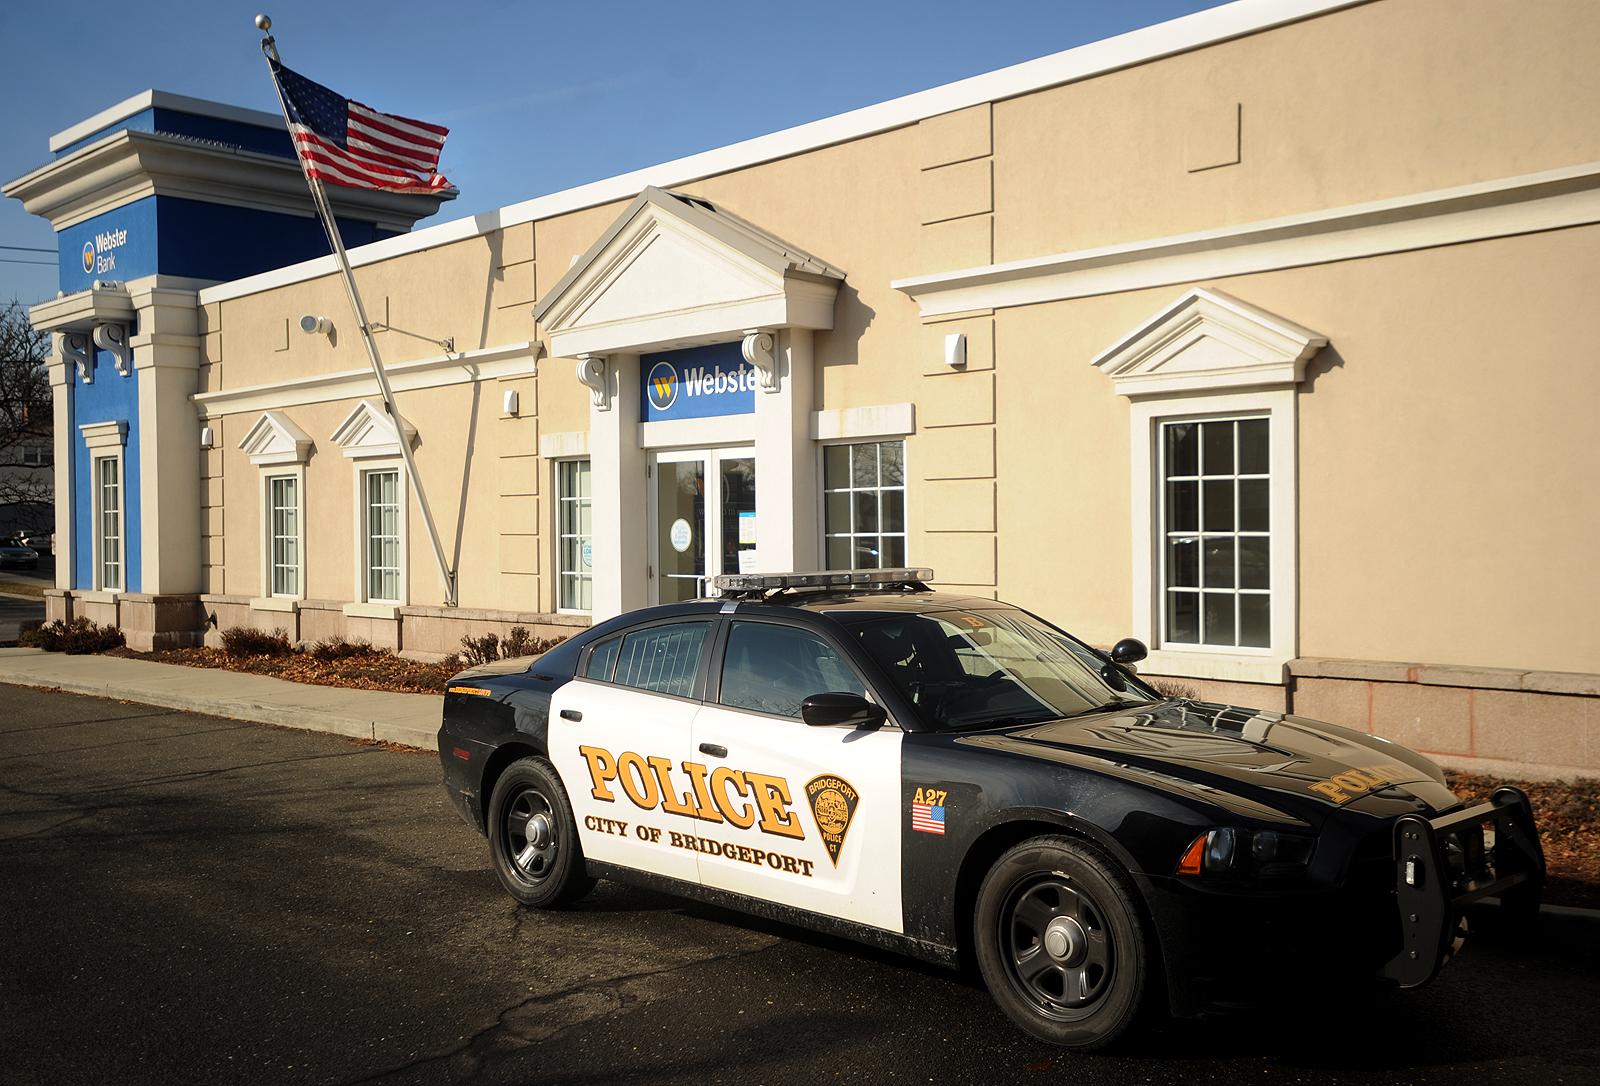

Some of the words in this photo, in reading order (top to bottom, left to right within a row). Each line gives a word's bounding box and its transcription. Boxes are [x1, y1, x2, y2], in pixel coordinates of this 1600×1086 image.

[95, 229, 127, 253] Webster
[97, 252, 116, 274] Bank
[684, 363, 756, 397] Webste
[579, 744, 806, 841] POLICE
[808, 778, 857, 802] BRIDGEPORT
[913, 787, 948, 807] A27
[584, 815, 629, 838] CITY
[635, 825, 662, 844] OF
[668, 830, 814, 877] BRIDGEPORT
[822, 831, 843, 844] POLICE
[829, 843, 837, 853] CT
